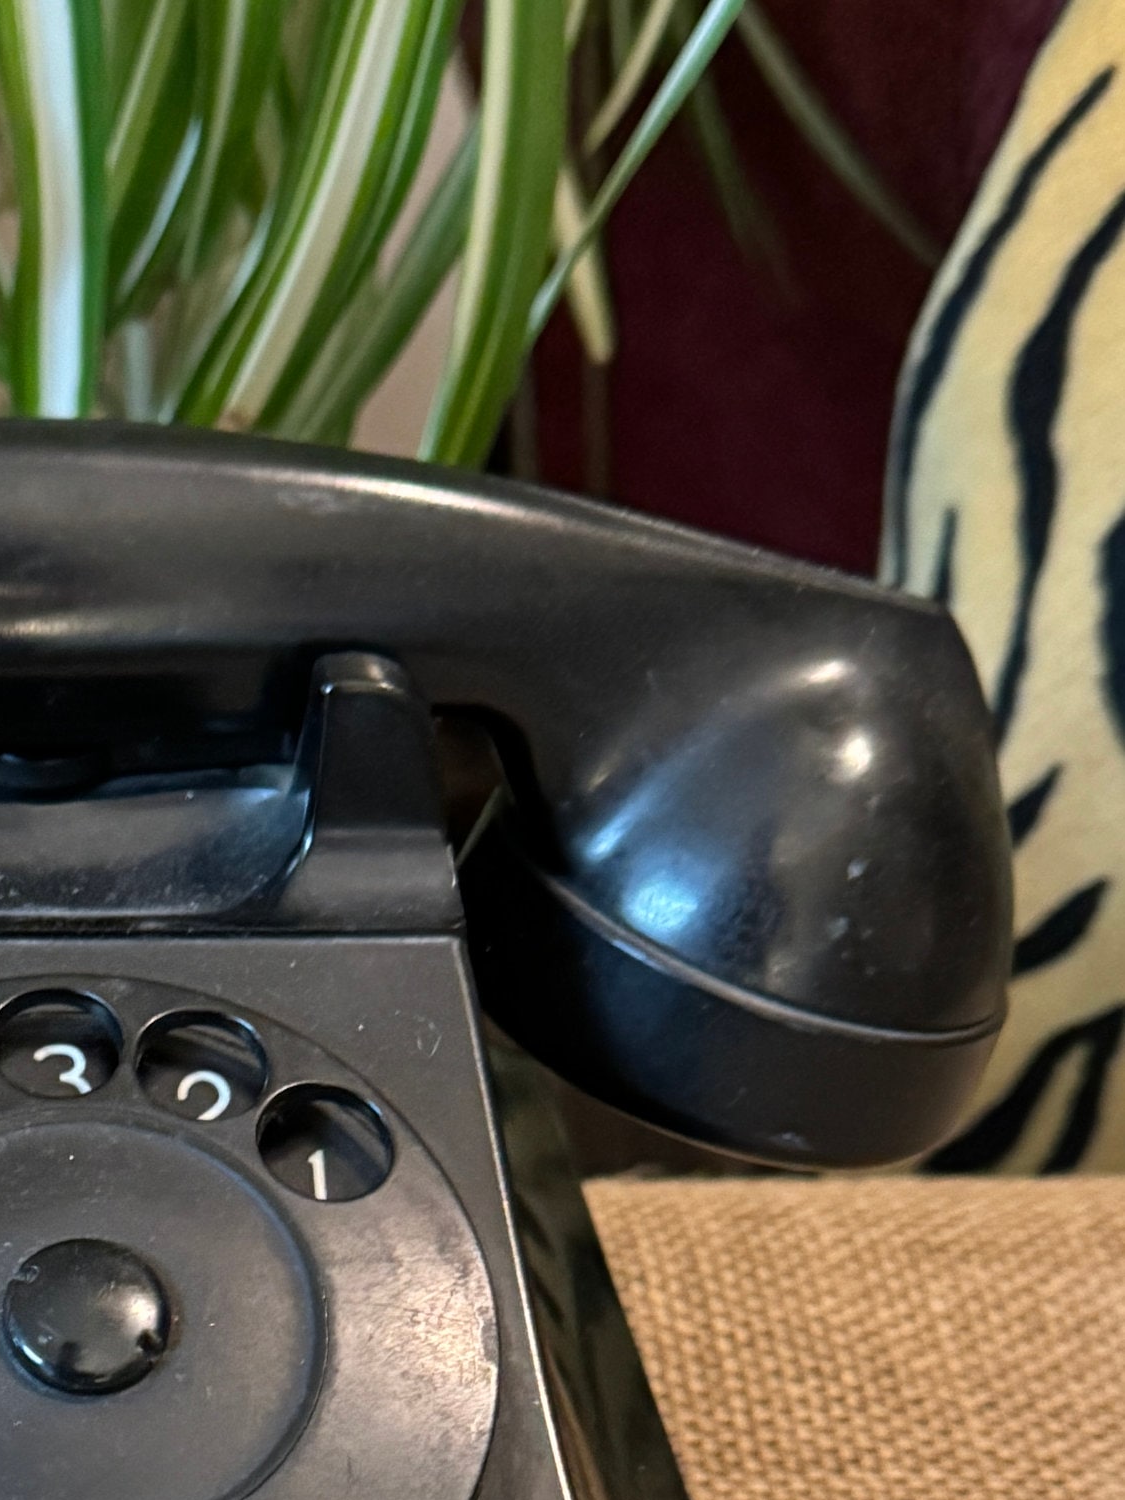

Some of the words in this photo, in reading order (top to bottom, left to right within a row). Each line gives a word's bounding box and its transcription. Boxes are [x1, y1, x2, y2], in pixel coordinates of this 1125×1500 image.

[33, 1043, 92, 1095] 3
[176, 1070, 231, 1121] 2
[307, 1149, 328, 1201] 1
